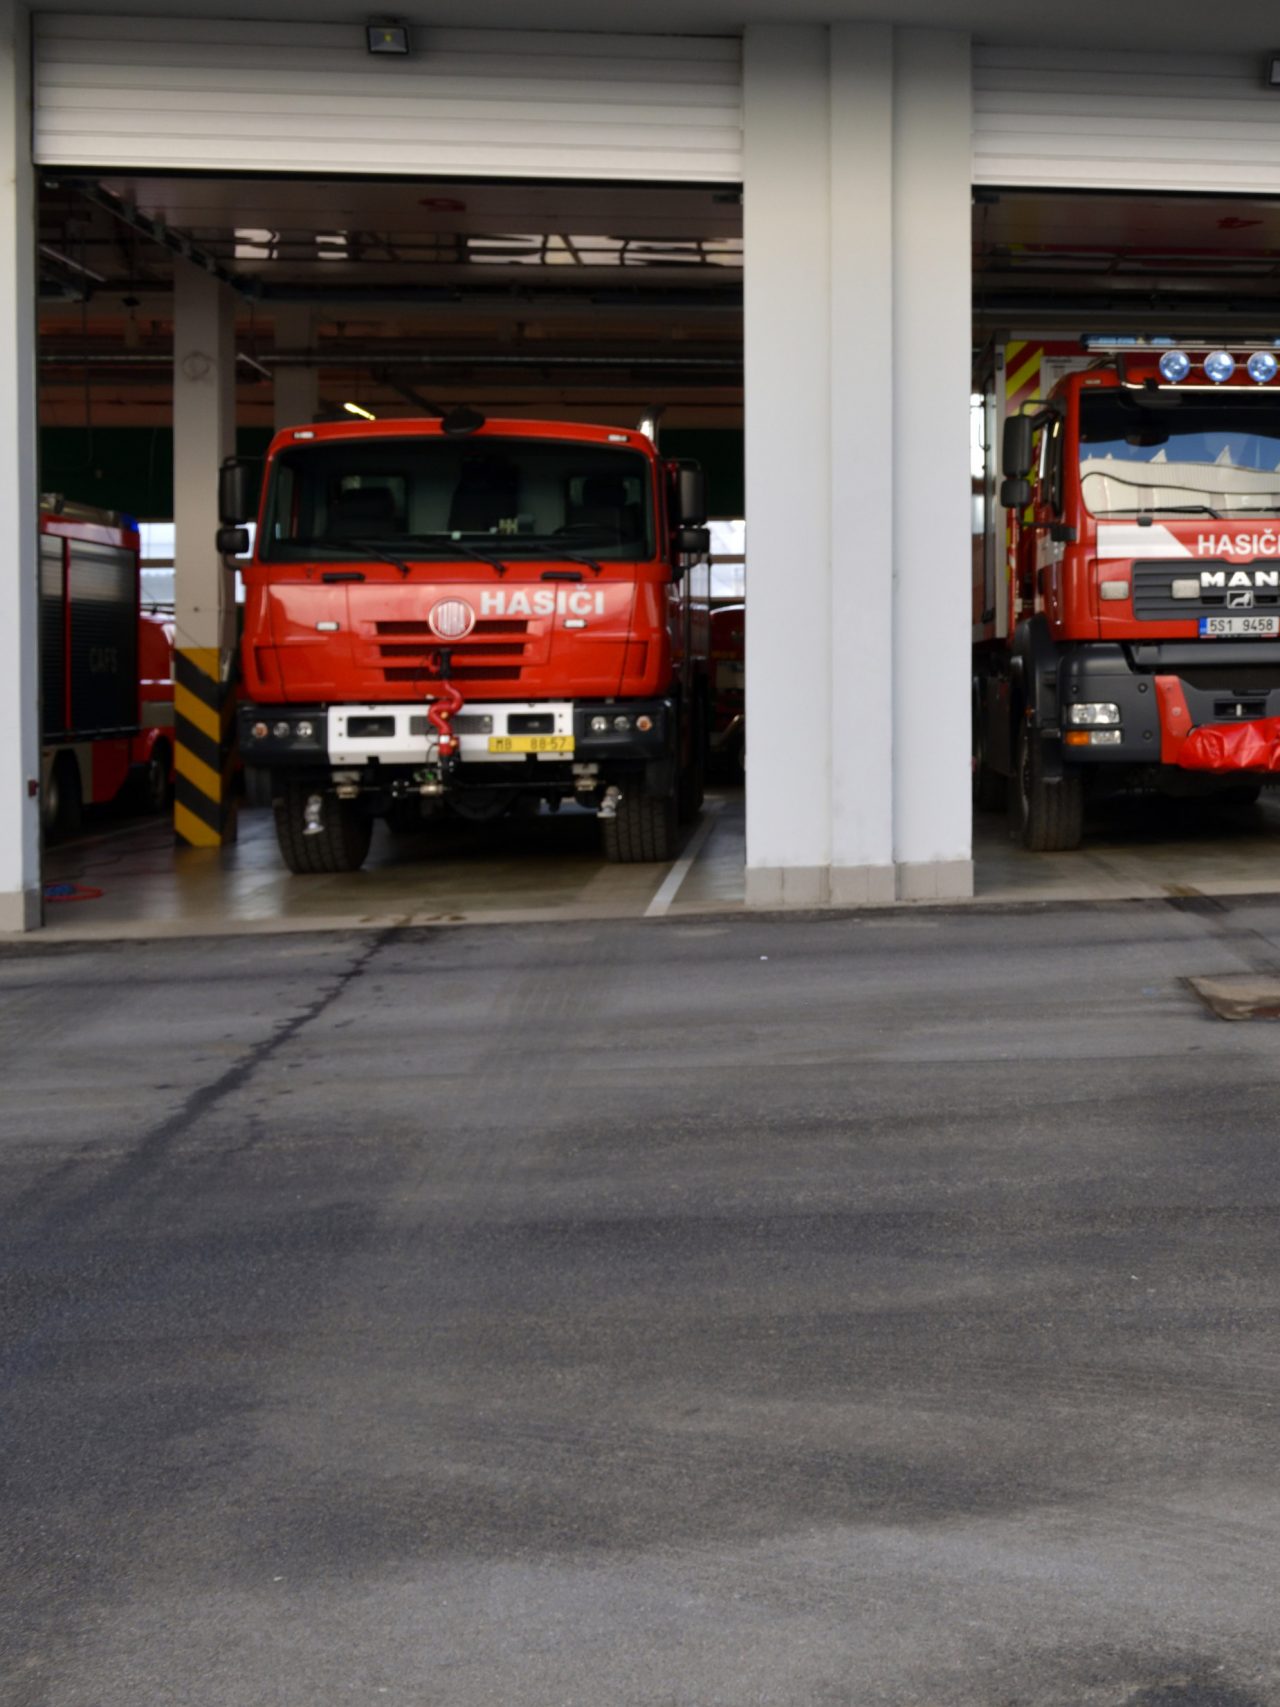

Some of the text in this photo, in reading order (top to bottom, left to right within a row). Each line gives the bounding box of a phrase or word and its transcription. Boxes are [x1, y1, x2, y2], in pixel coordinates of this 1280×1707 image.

[1201, 571, 1279, 587] MAN
[480, 585, 604, 615] HASIČI
[1210, 619, 1274, 632] 5S1 9458
